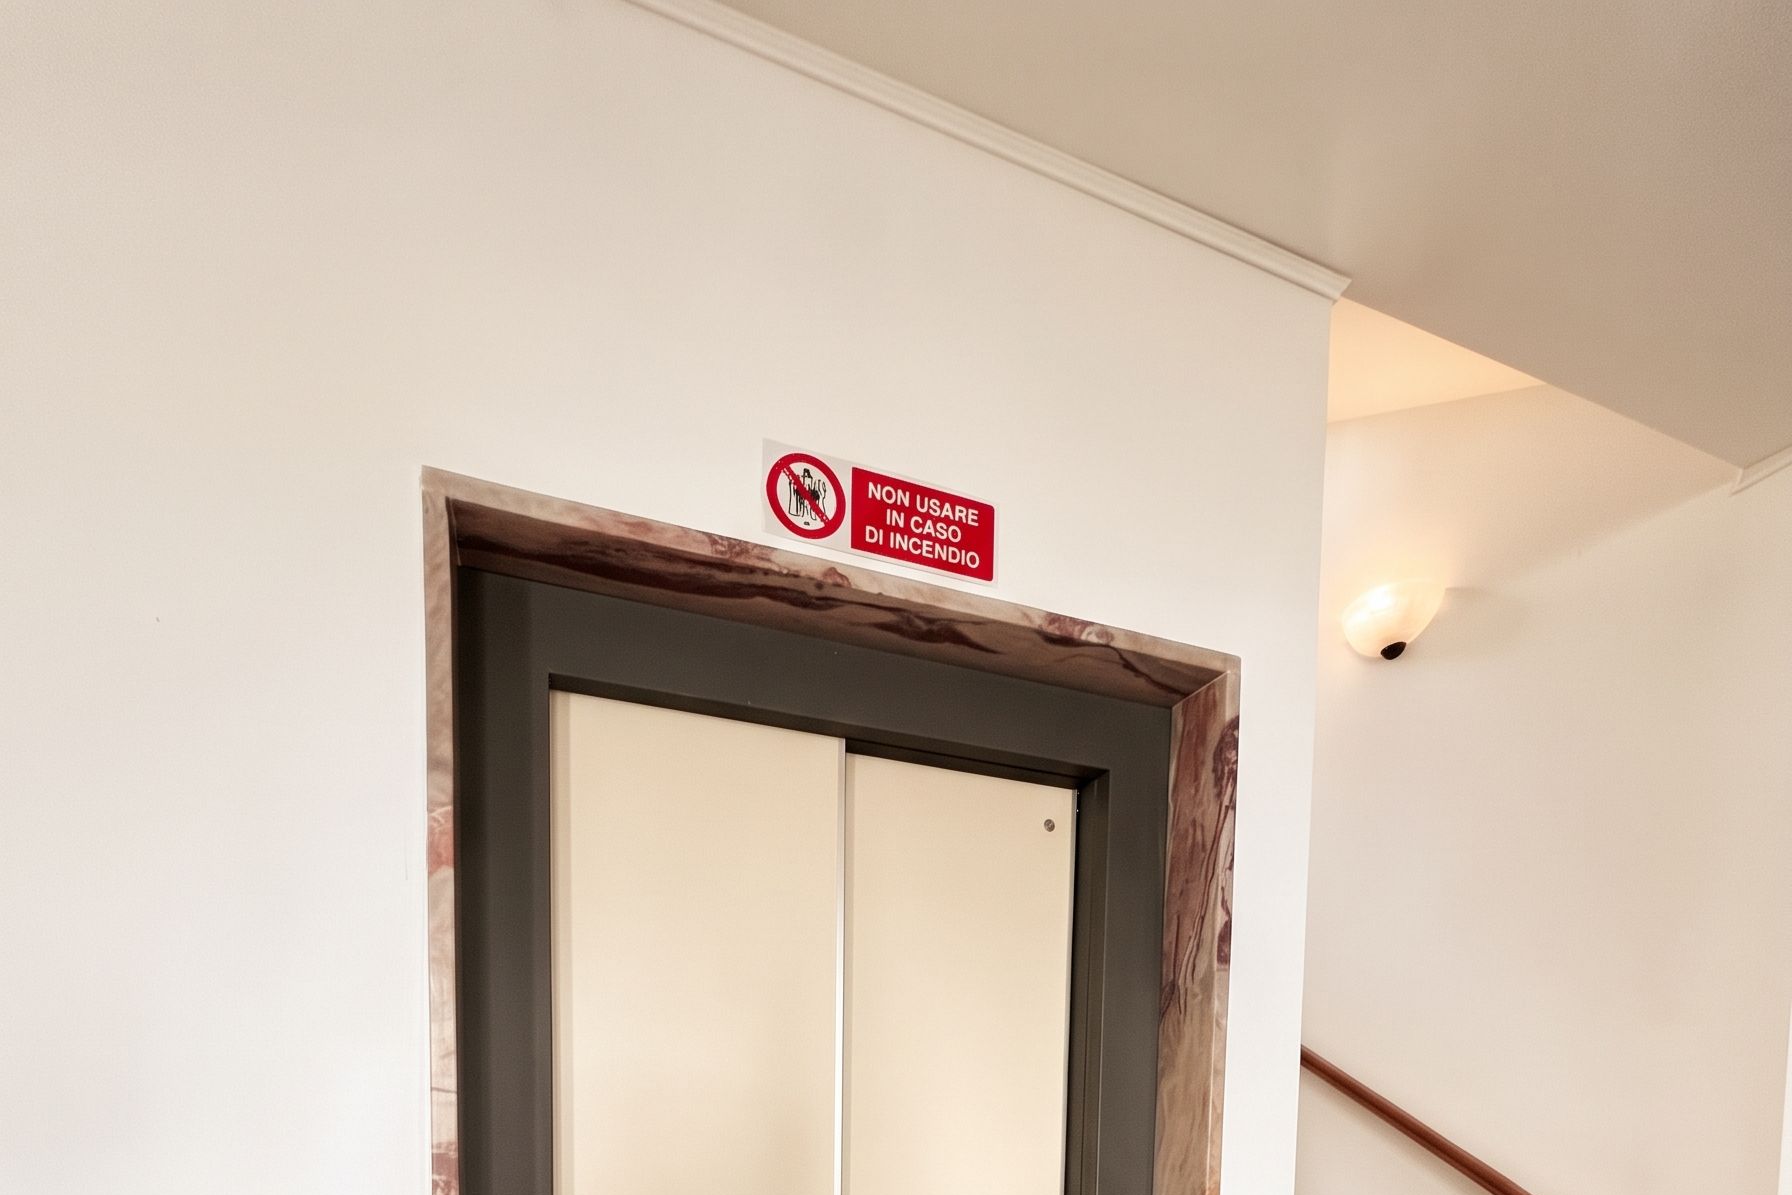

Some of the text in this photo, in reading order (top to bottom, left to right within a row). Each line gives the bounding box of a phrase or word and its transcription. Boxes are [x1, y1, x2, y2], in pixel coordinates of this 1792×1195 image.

[867, 481, 979, 527] NON USARE
[886, 509, 962, 543] IN CASO
[865, 525, 980, 569] DI INCENDIO
